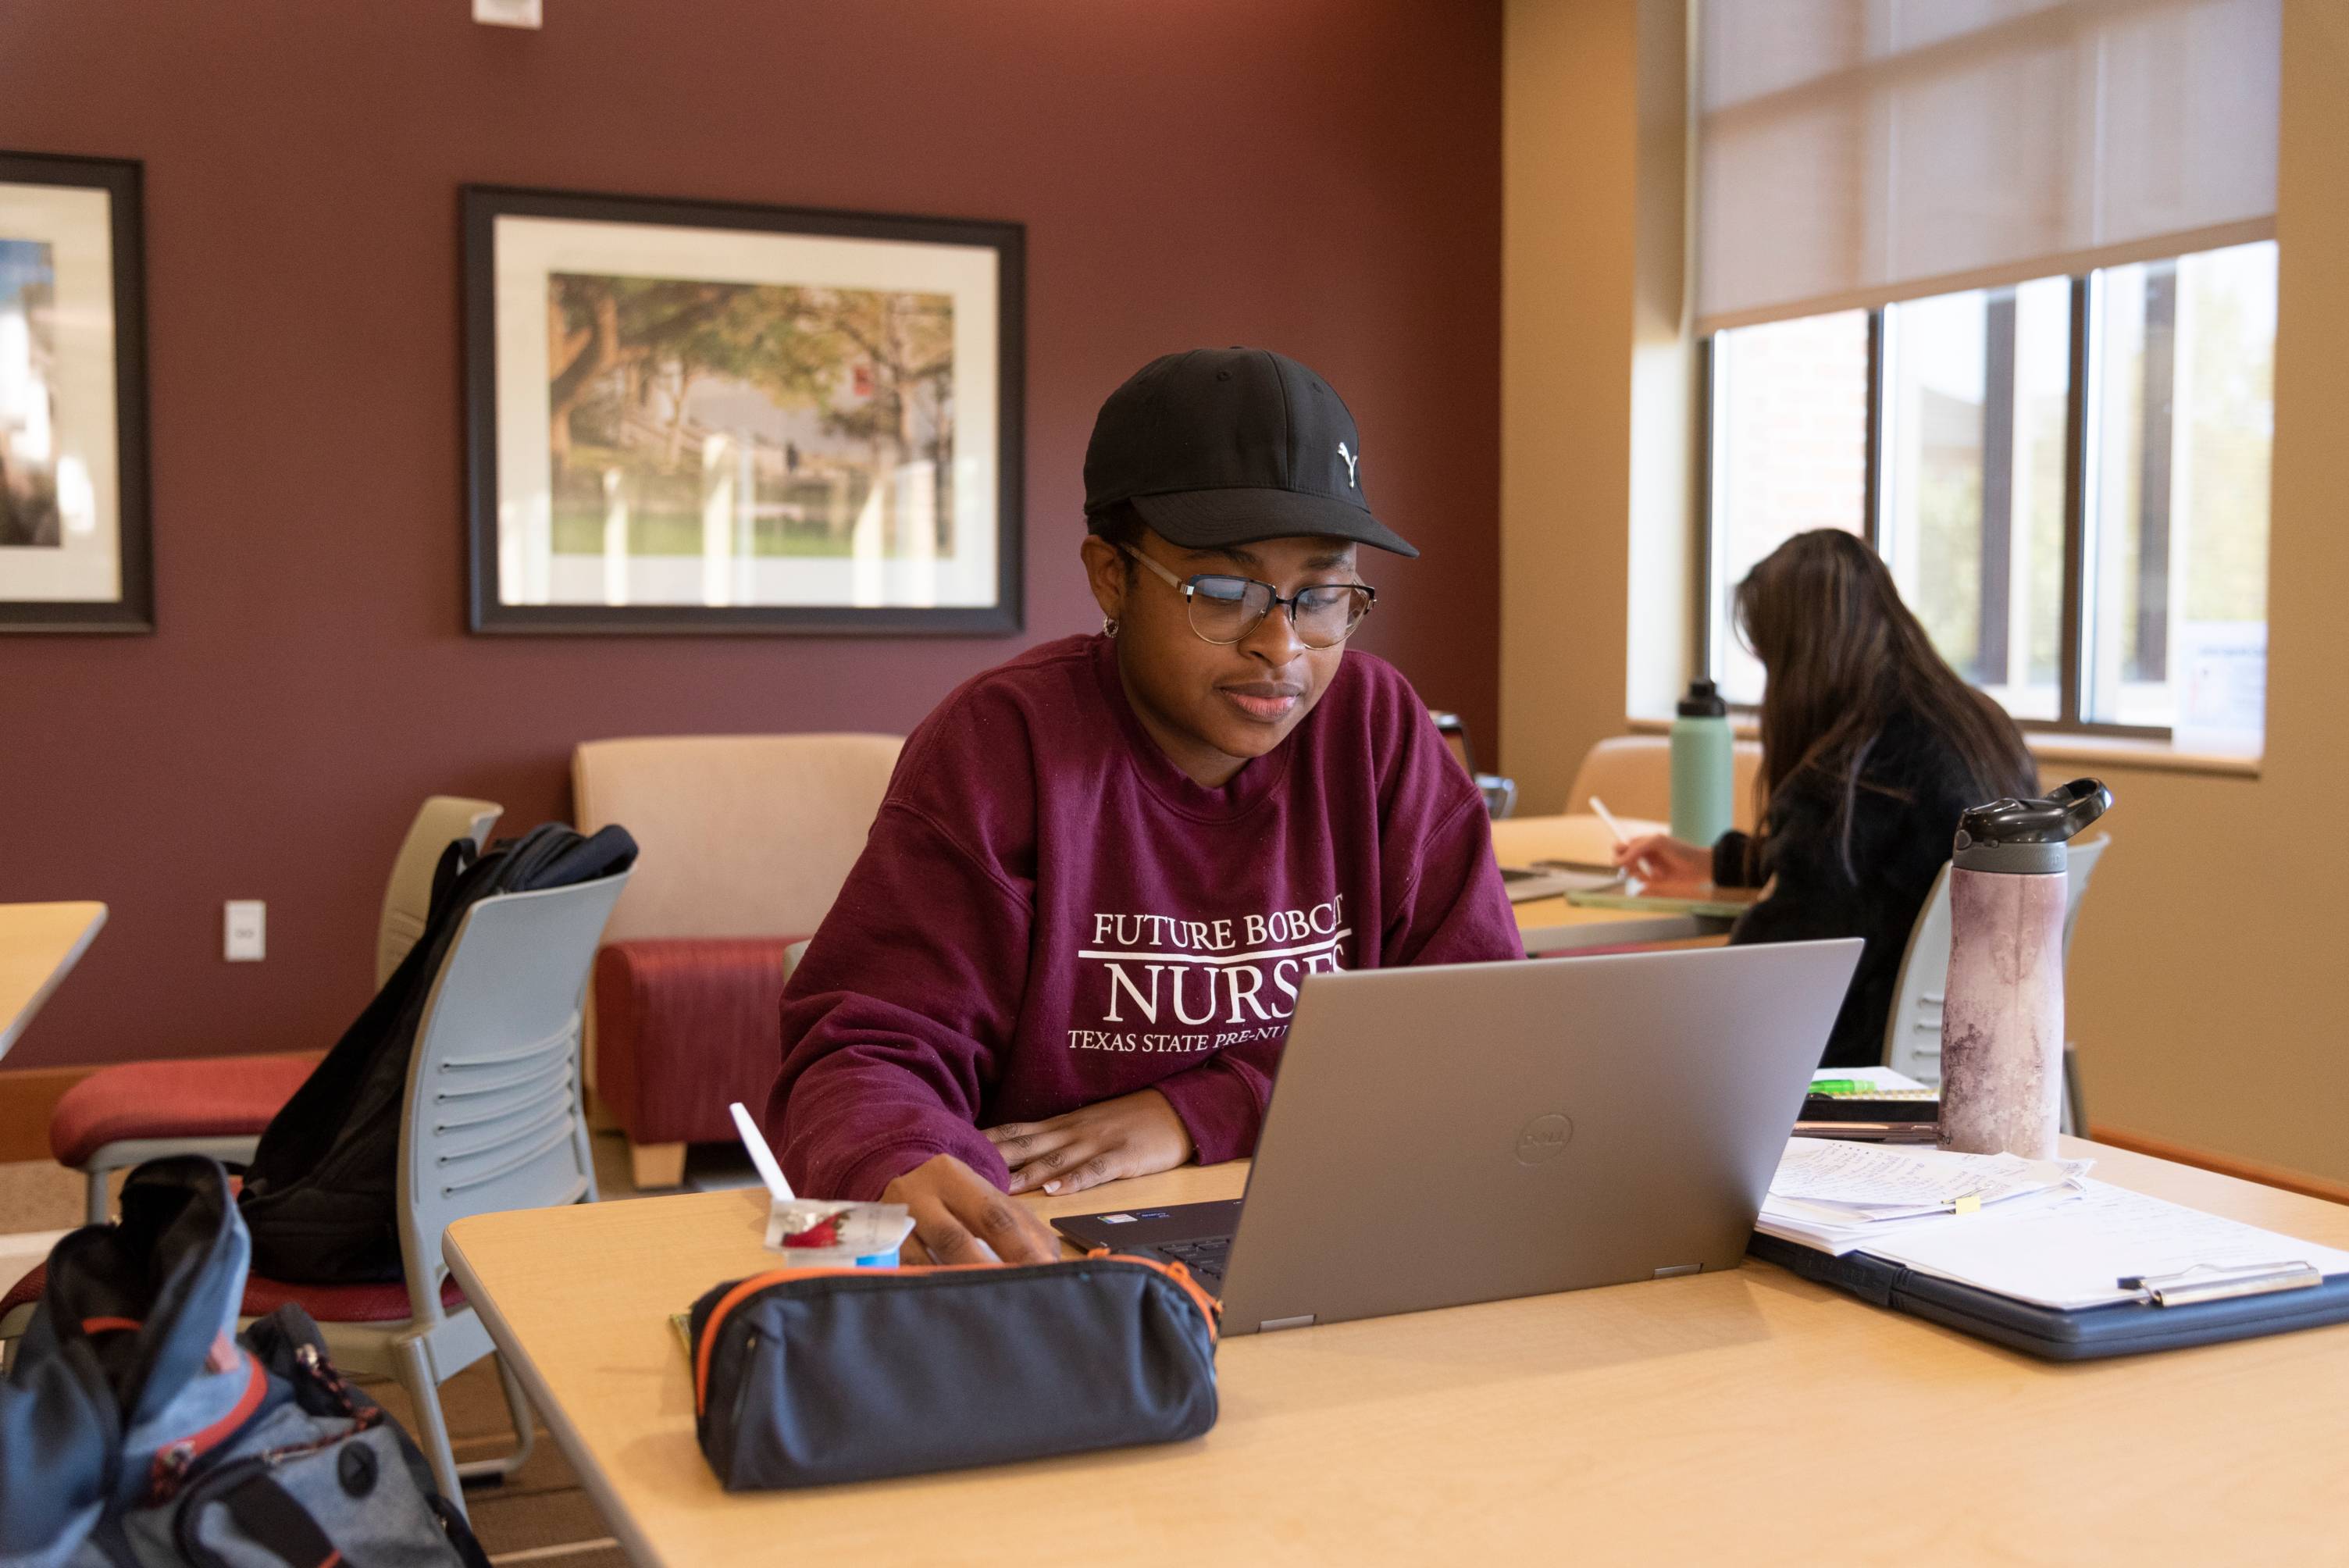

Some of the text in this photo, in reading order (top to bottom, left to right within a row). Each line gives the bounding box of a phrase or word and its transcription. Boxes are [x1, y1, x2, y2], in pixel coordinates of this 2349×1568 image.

[1092, 893, 1343, 950] FUTURE BOBCT
[1068, 1030, 1136, 1052] TEXAS
[1142, 1034, 1209, 1053] STATE
